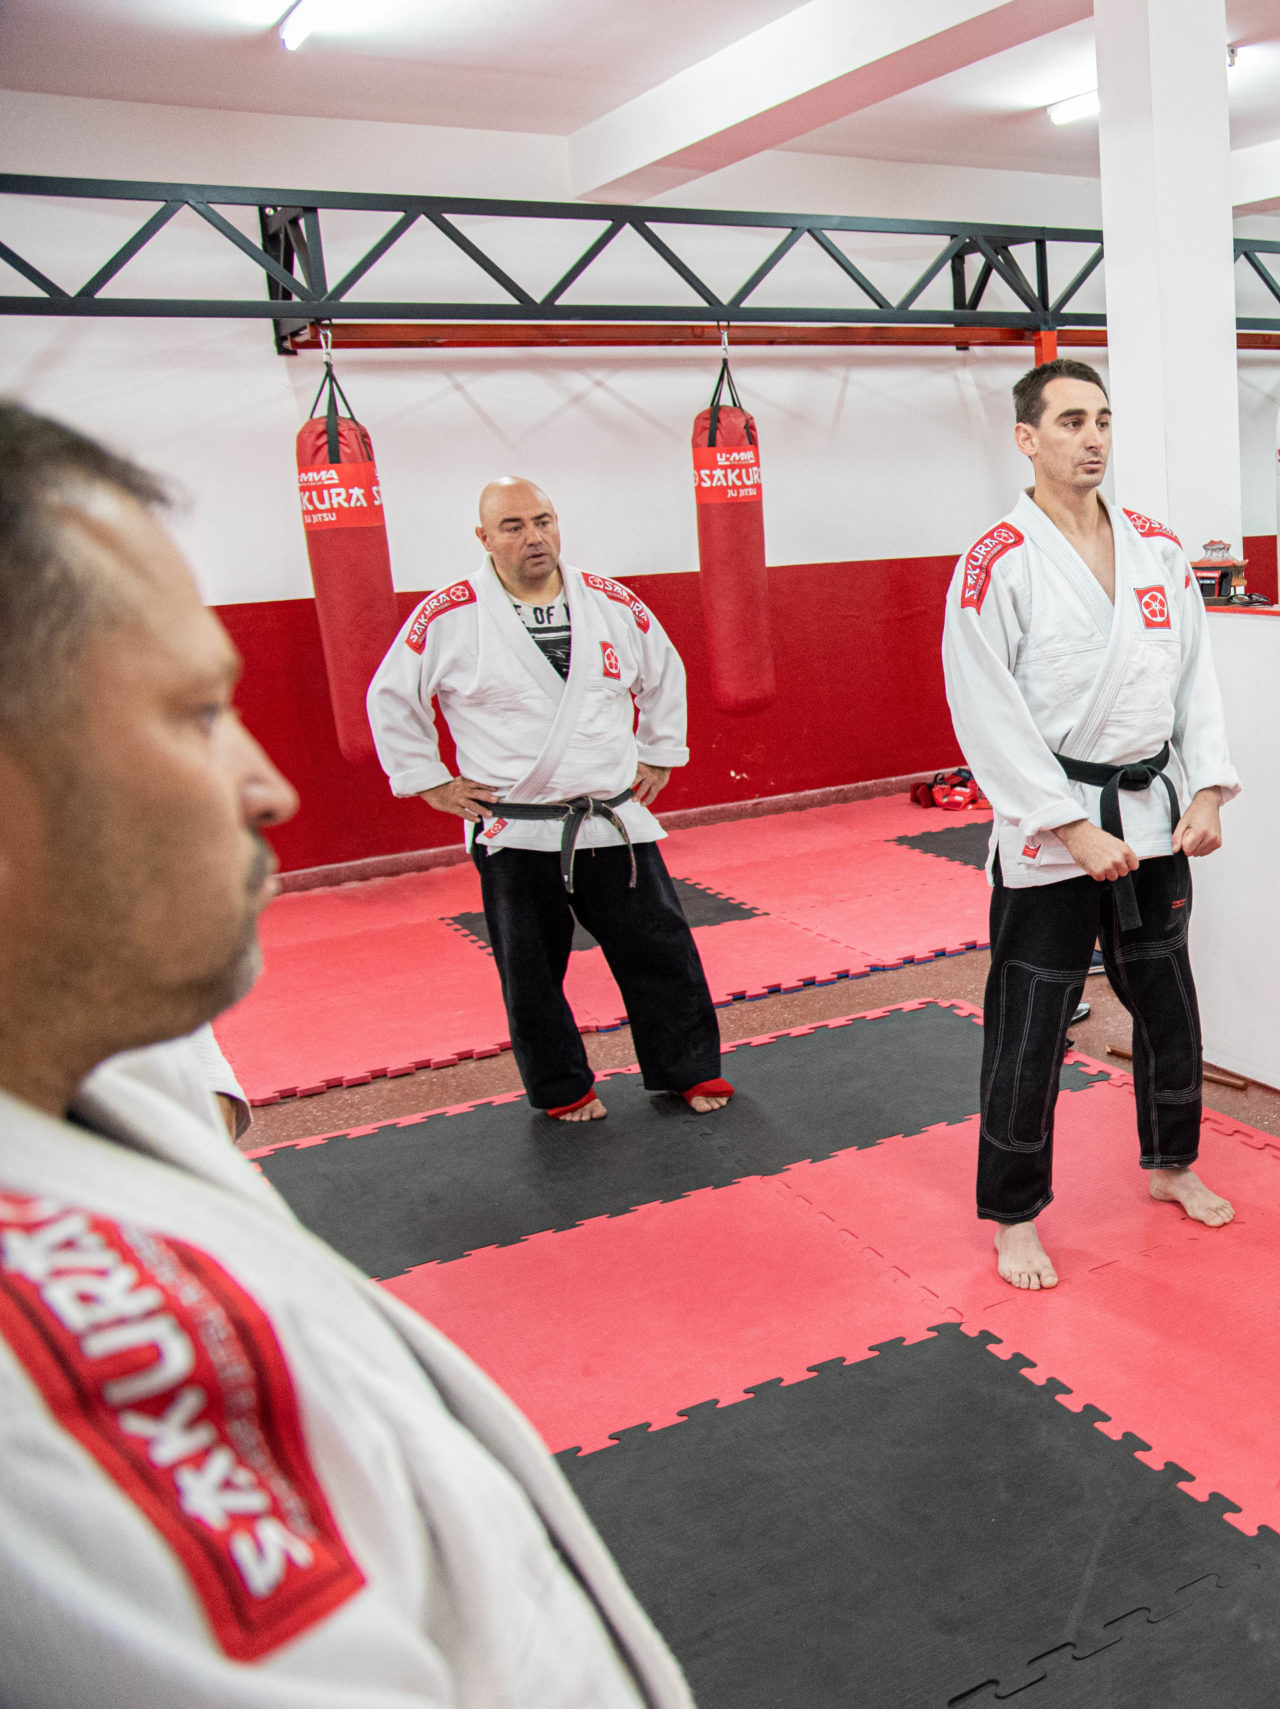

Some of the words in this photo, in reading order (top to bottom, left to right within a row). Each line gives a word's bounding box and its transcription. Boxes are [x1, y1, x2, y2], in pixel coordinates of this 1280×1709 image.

[299, 469, 339, 482] MMA
[700, 466, 761, 488] SAKUR
[300, 486, 368, 511] KURA
[533, 605, 555, 625] OF
[2, 1212, 314, 1598] SAKURA
